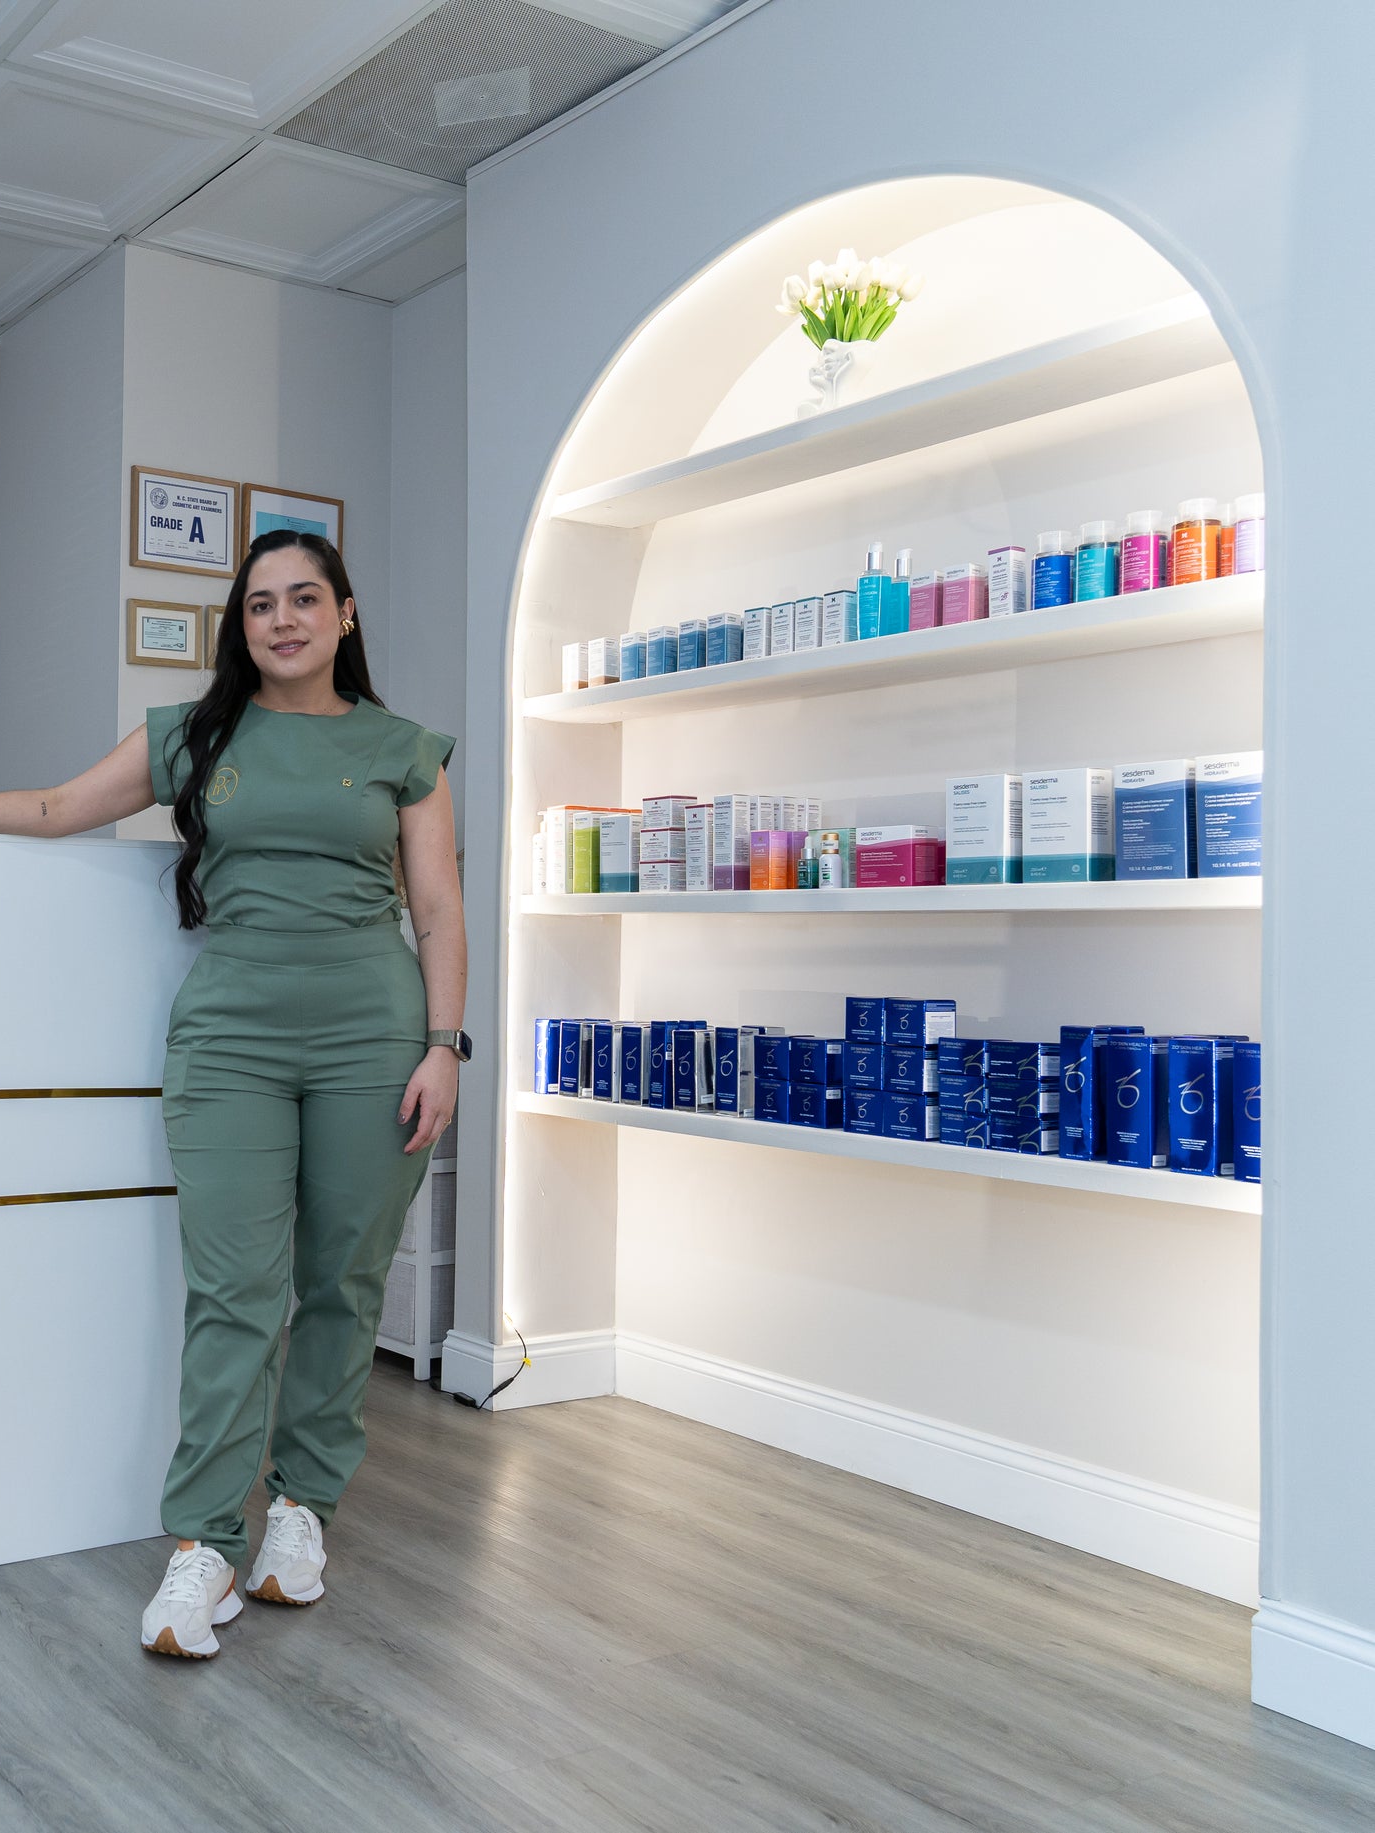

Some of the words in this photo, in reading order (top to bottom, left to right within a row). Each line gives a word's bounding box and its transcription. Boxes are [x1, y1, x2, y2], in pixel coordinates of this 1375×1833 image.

[172, 501, 192, 509] COSMETIC
[150, 515, 183, 531] GRADE
[189, 516, 205, 544] A
[1204, 761, 1240, 770] sesderma
[1122, 769, 1155, 778] sesderma
[1030, 777, 1058, 785] sesderma
